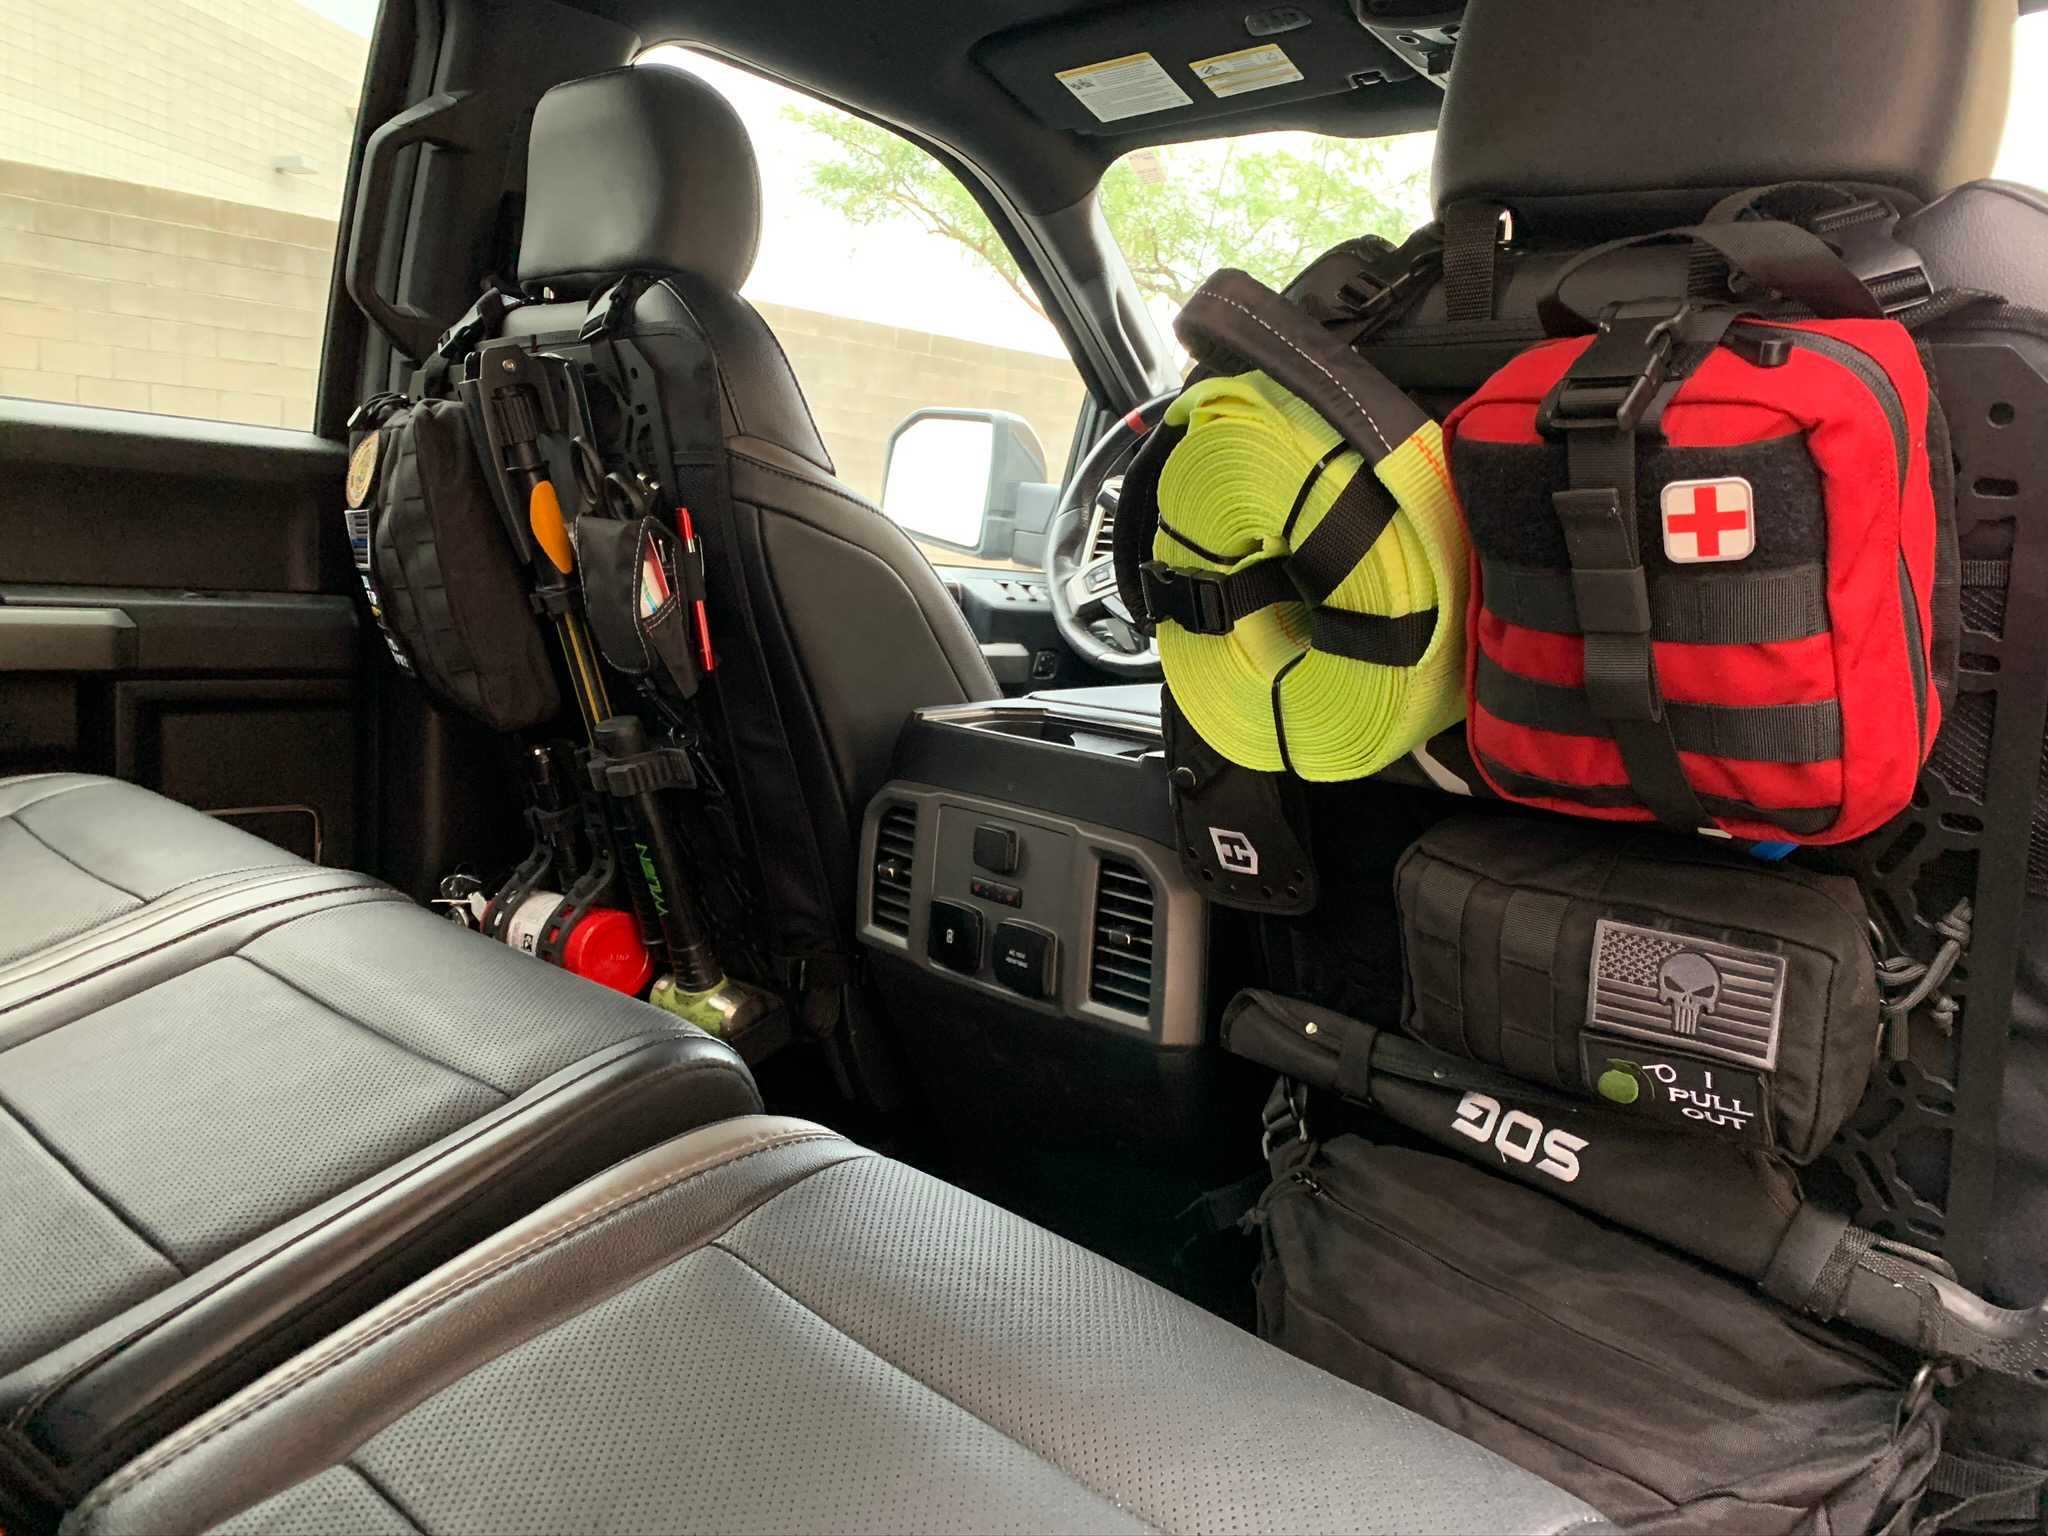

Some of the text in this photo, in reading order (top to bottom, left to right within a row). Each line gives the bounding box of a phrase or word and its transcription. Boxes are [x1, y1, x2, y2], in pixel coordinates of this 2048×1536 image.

[1704, 1070, 1713, 1089] I
[1668, 1086, 1755, 1118] PULL
[1681, 1107, 1747, 1130] OUT
[1450, 1090, 1590, 1183] SOG
